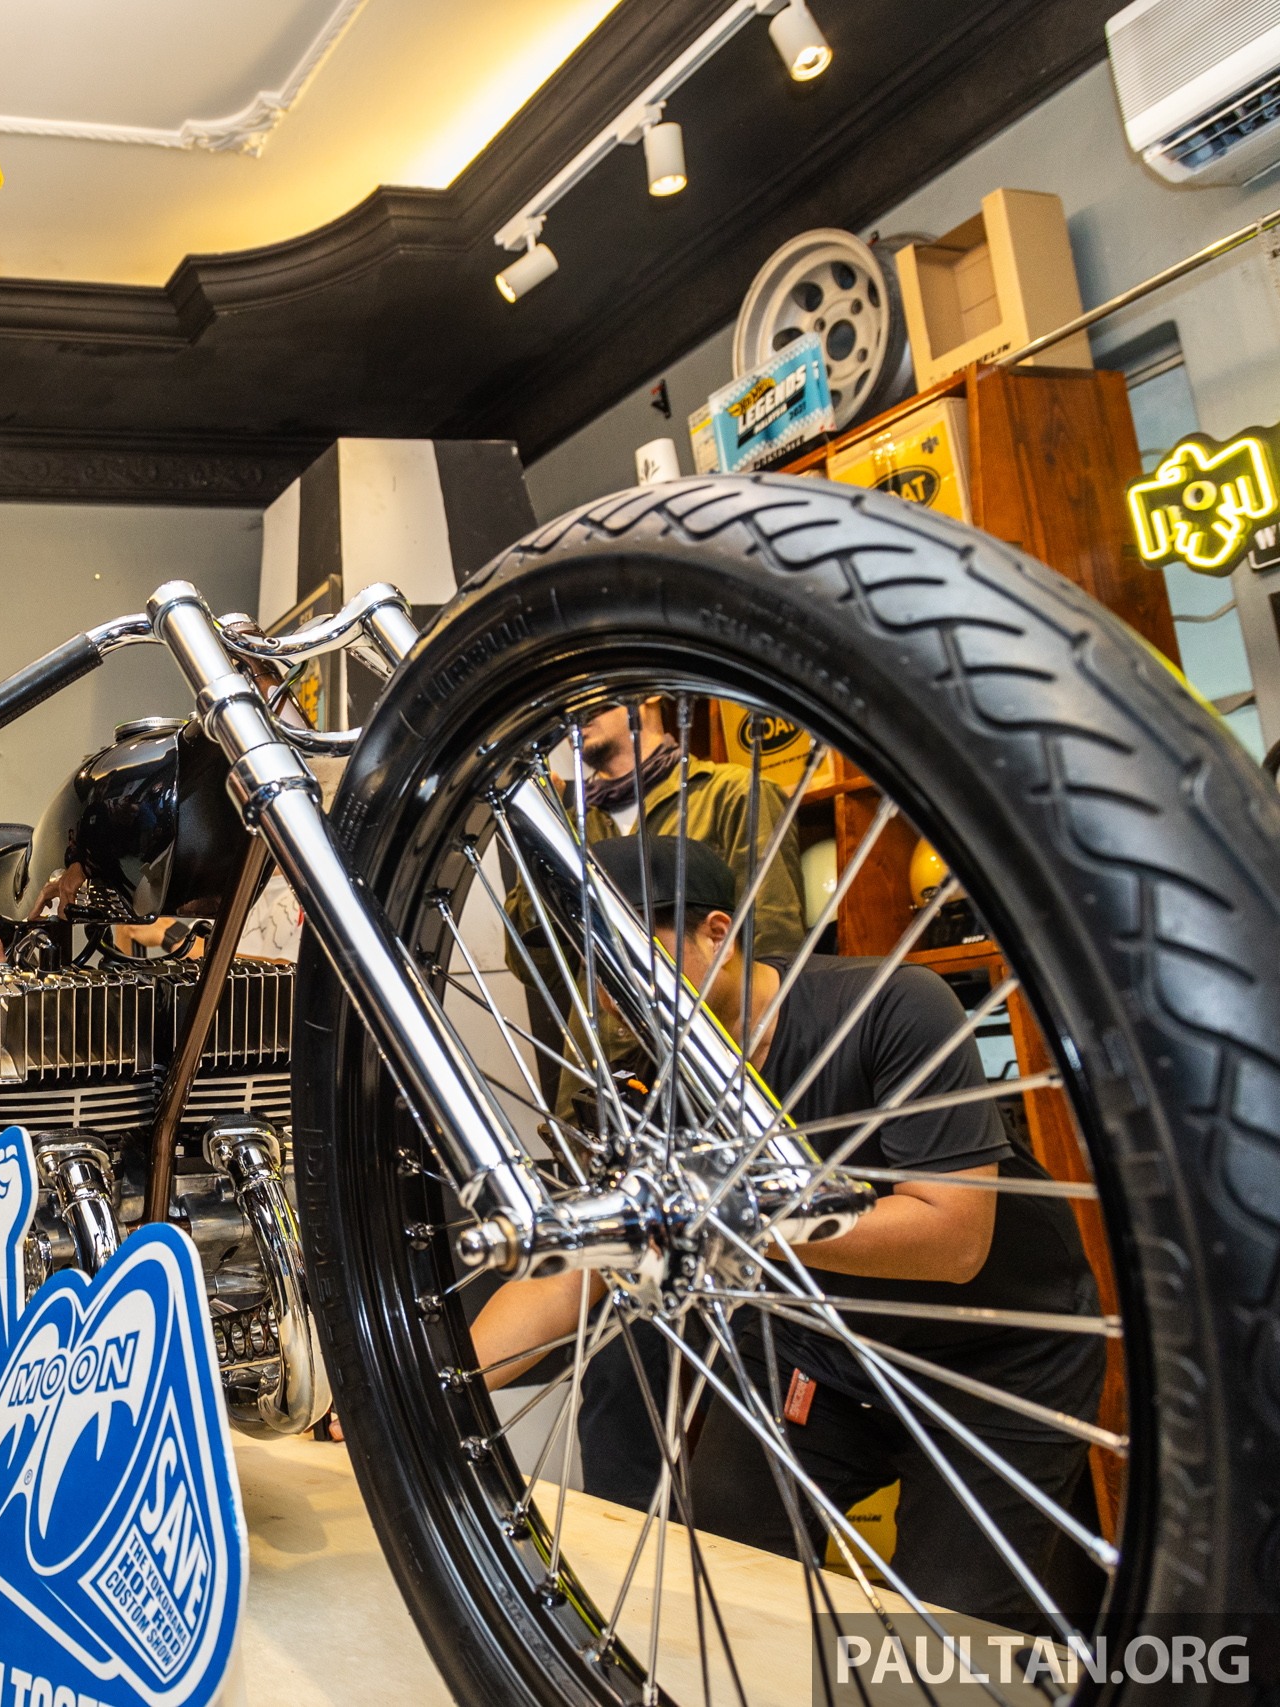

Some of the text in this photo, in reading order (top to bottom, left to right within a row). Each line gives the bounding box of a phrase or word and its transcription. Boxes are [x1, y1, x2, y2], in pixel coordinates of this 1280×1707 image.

[737, 363, 807, 436] LEGENDS
[8, 1330, 141, 1408] MOON
[138, 1436, 209, 1631] SAVE
[105, 1570, 174, 1668] CUSTOM SHOW
[118, 1551, 181, 1657] HOT ROD
[128, 1532, 188, 1647] THE YOKOHAMA
